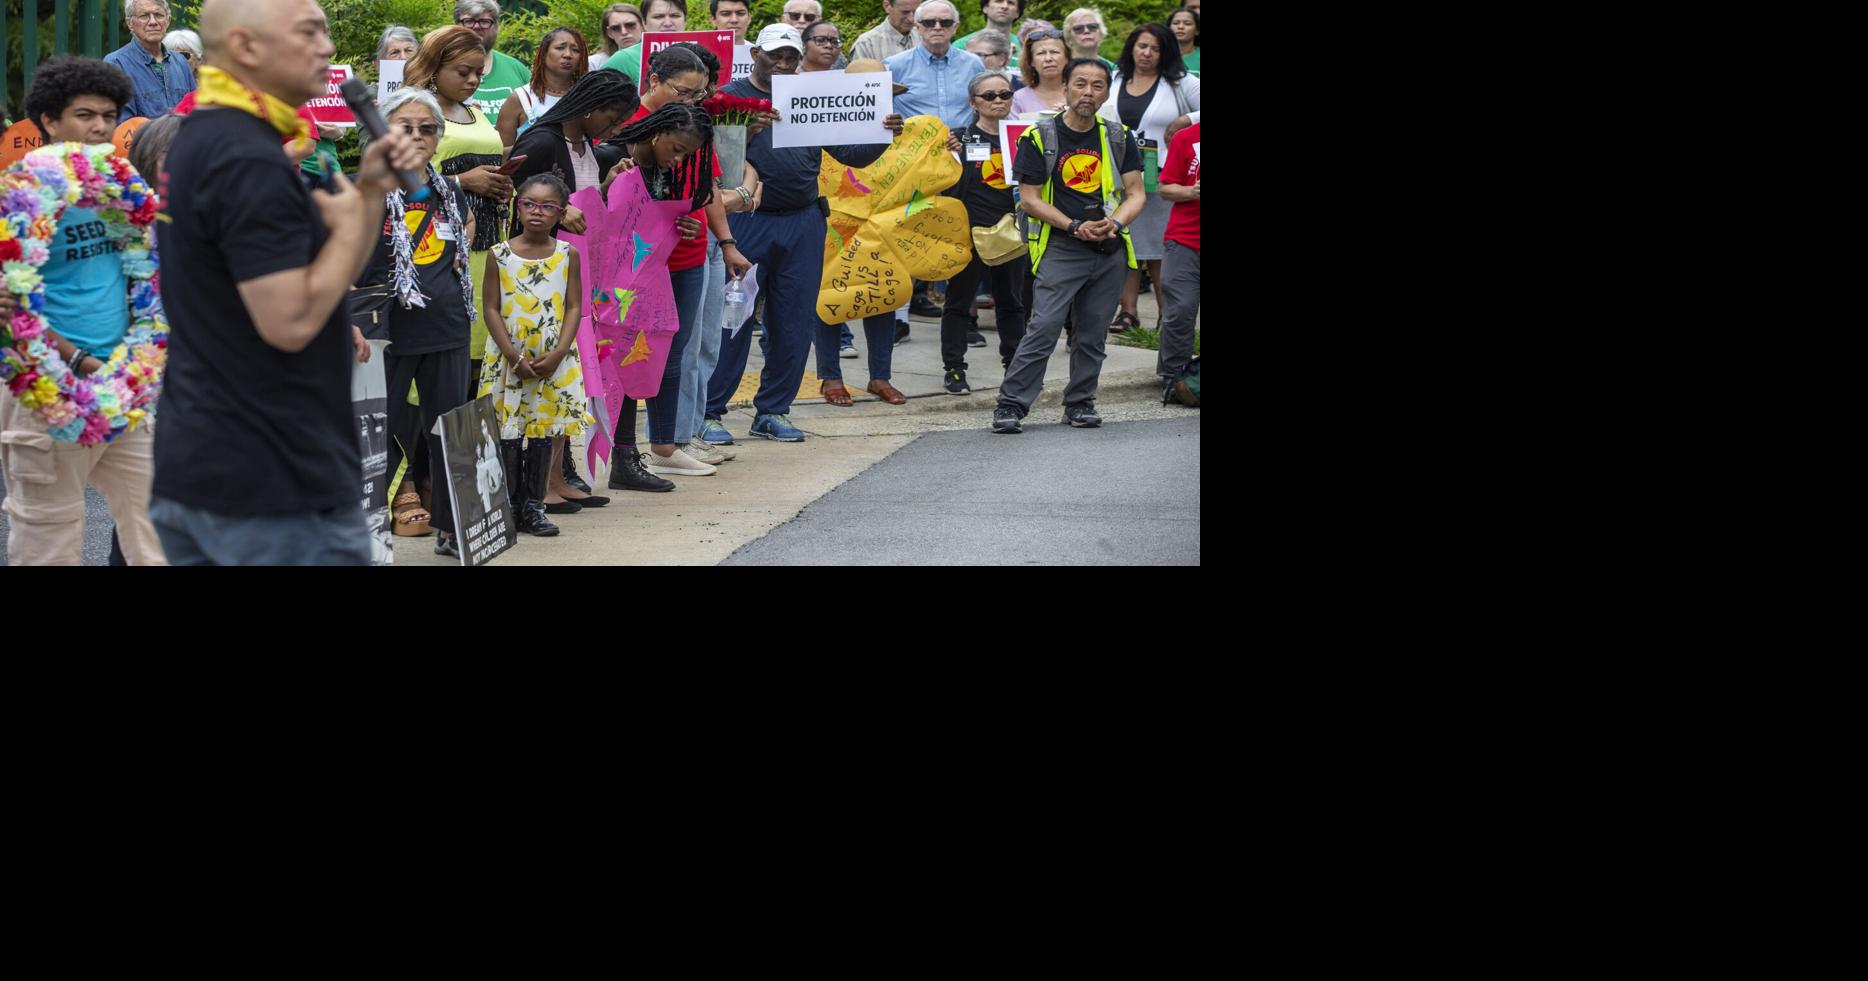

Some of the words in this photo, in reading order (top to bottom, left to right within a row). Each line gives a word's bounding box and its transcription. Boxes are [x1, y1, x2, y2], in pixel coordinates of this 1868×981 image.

[306, 95, 347, 108] ETENCIÓN
[791, 91, 876, 110] PROTECCIÓN
[790, 113, 808, 124] NO
[810, 108, 876, 123] DETENCIÓN
[64, 220, 107, 244] SEED
